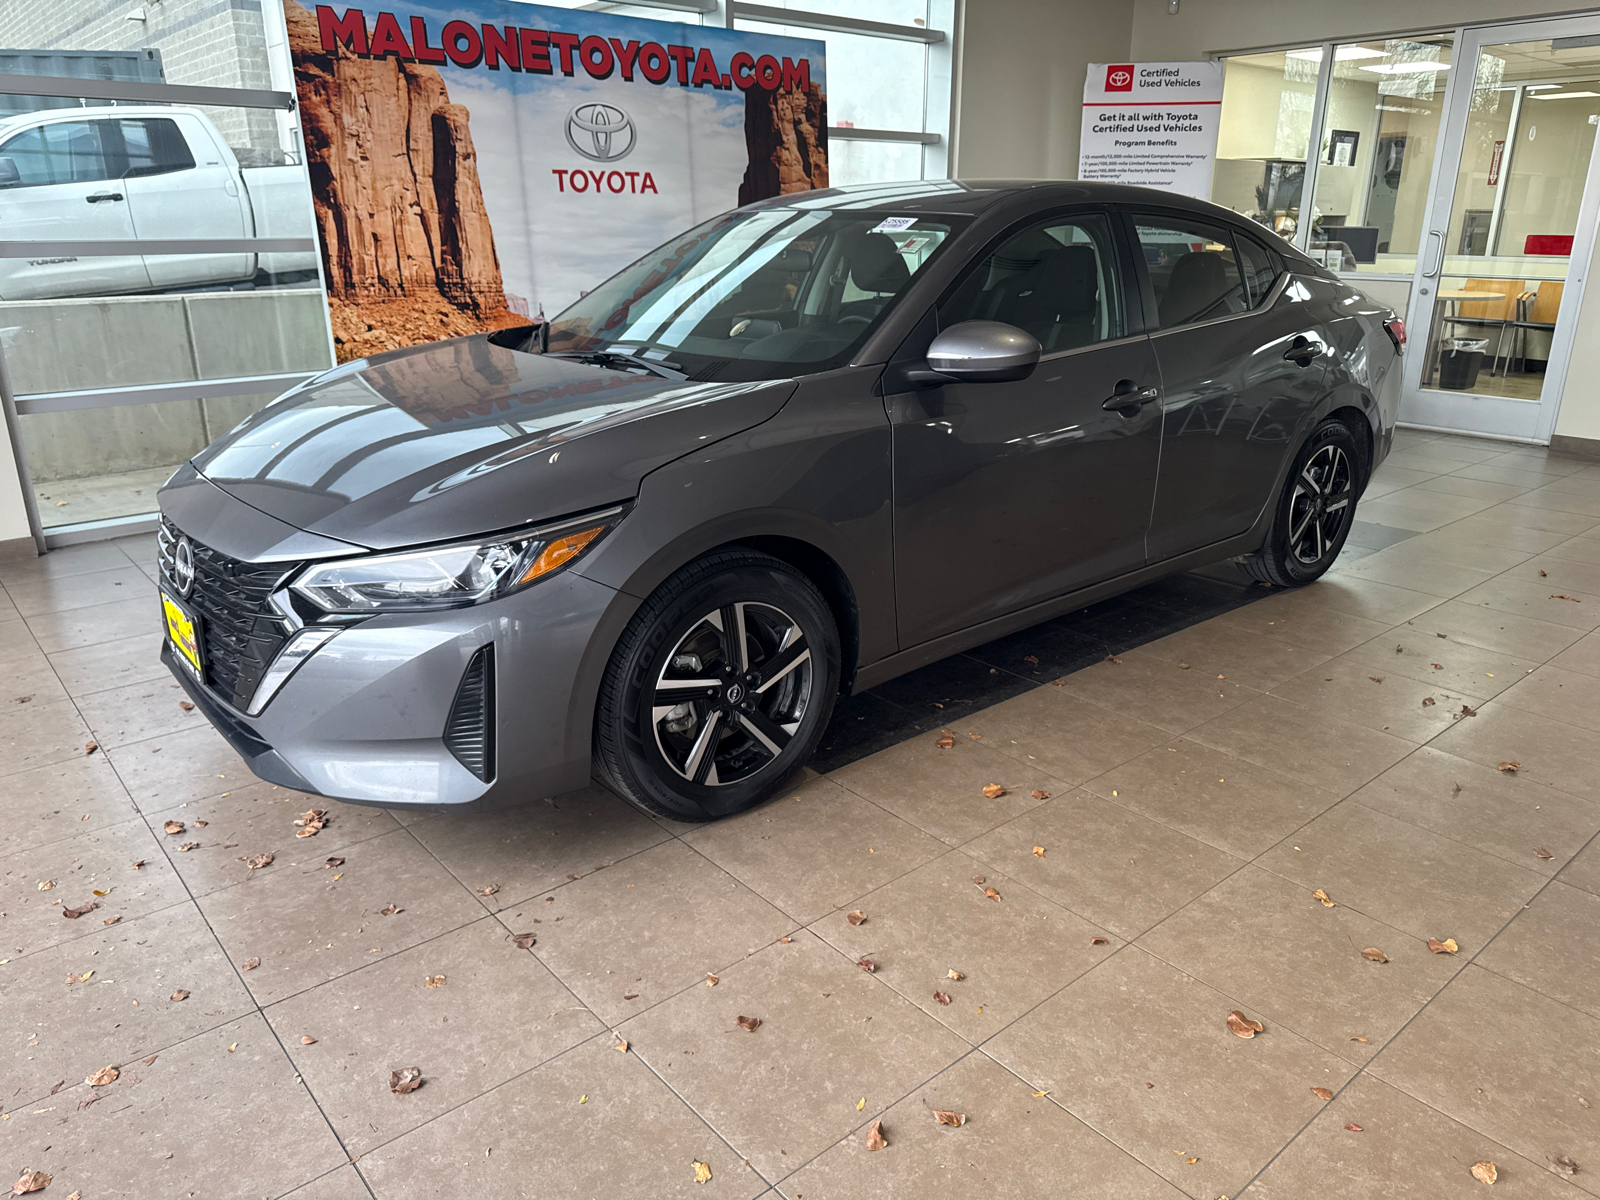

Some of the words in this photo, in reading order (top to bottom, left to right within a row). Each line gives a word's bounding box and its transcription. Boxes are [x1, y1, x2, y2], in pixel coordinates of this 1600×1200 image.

[1140, 68, 1180, 77] Certified
[1139, 79, 1162, 88] Used
[1163, 78, 1201, 87] Vehicles
[1099, 113, 1117, 122] Get
[1118, 113, 1126, 121] it
[1127, 113, 1140, 121] all
[1142, 112, 1164, 121] with
[1165, 112, 1198, 122] Toyota
[1092, 124, 1135, 133] Certified
[1136, 124, 1161, 132] Used
[1162, 123, 1203, 132] Vehicles
[1114, 140, 1146, 148] Program
[552, 169, 659, 195] TOYOTA
